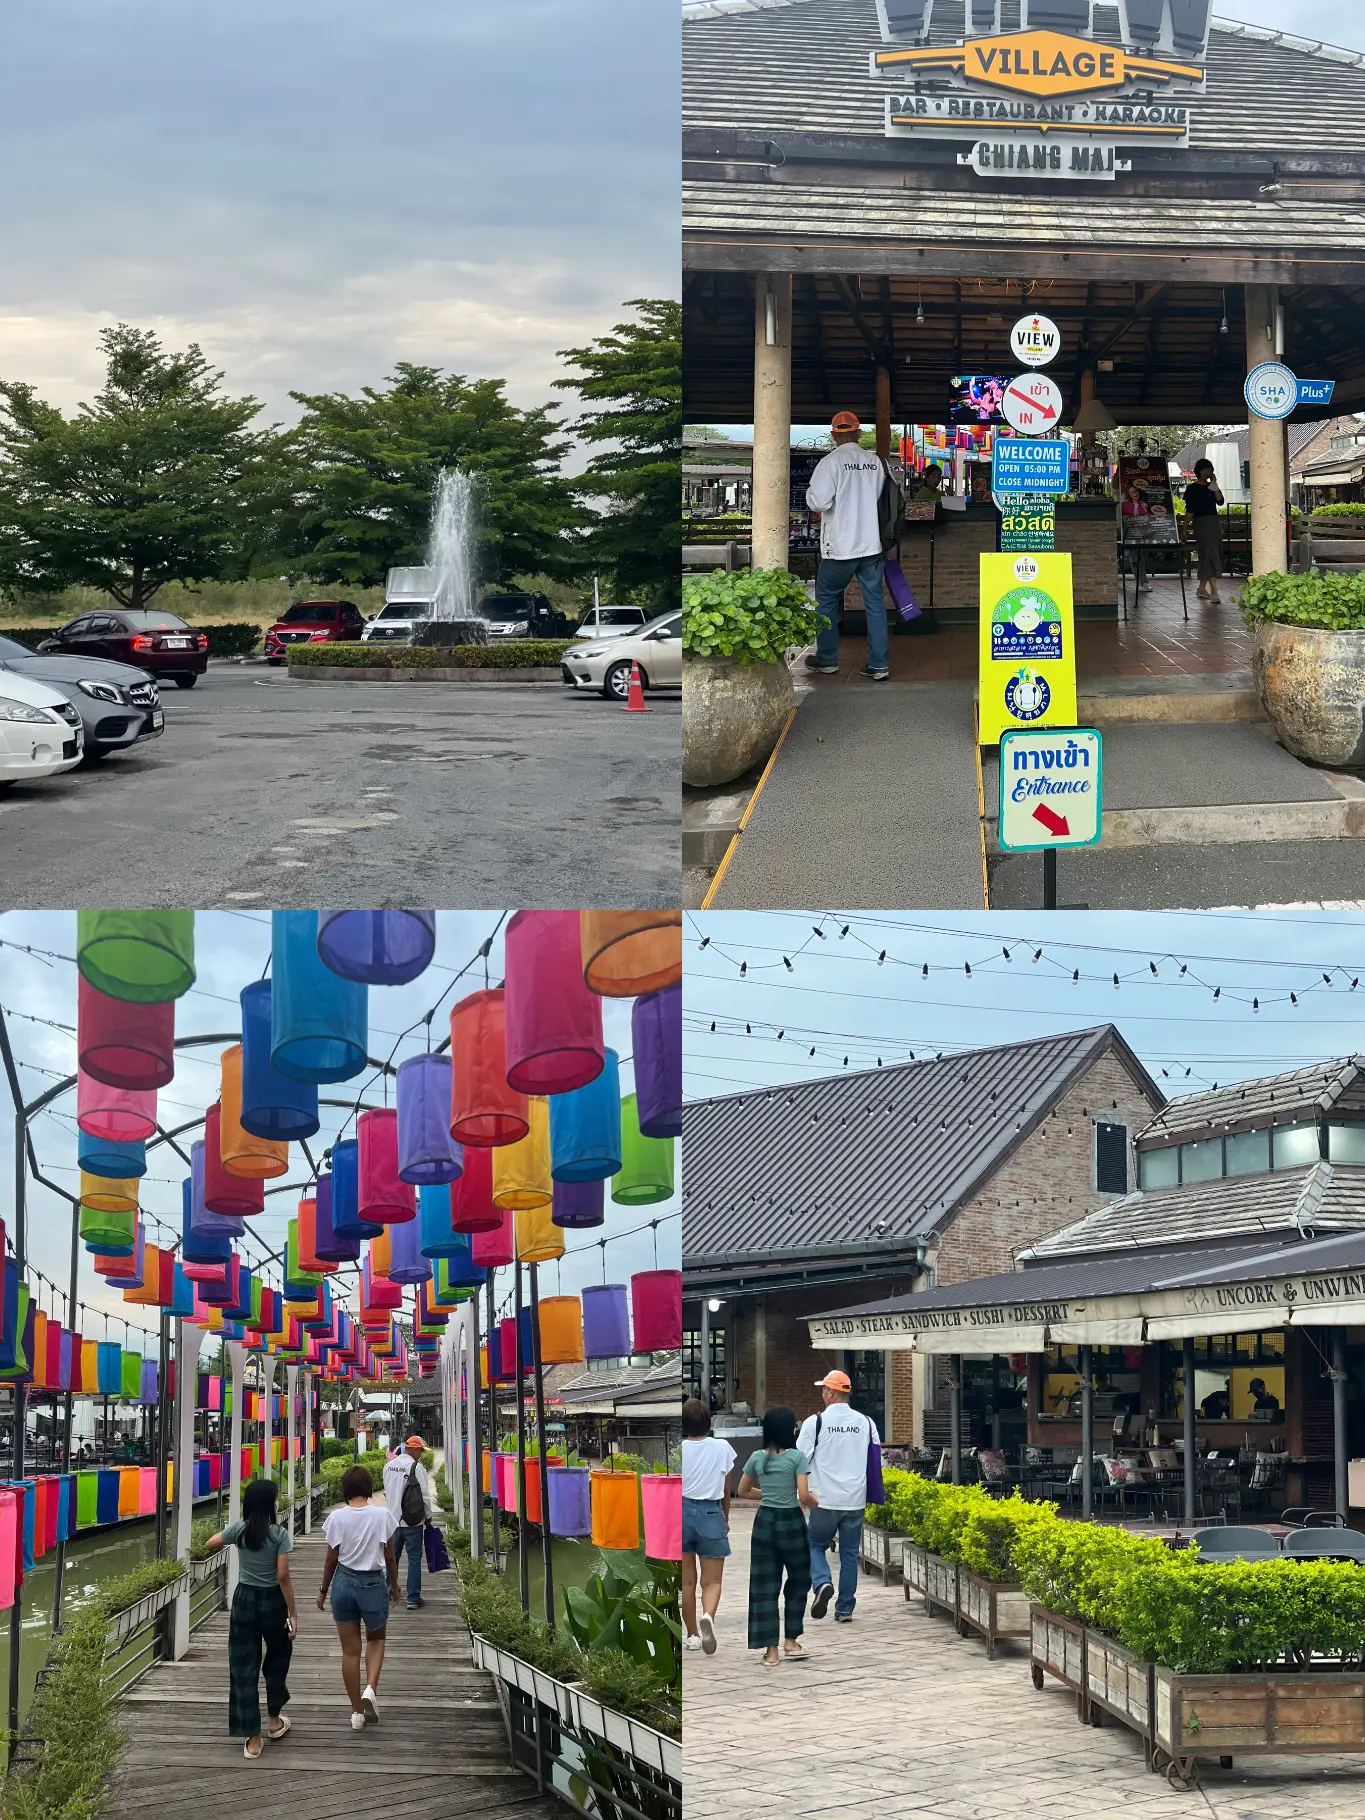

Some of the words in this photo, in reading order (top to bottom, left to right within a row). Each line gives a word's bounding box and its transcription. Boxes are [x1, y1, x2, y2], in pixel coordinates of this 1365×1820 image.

[975, 47, 1115, 79] VILLAGE
[889, 96, 928, 114] BAR
[948, 99, 1075, 122] RESTAURANT
[1094, 105, 1187, 124] KARAOKE
[978, 142, 1061, 169] CHIANG
[1071, 147, 1114, 172] MAI
[1017, 331, 1054, 347] VIEW
[1030, 382, 1050, 396] เข้า
[1260, 386, 1286, 396] SHA
[1019, 413, 1033, 424] IN
[999, 445, 1062, 461] WELCOME
[844, 463, 878, 471] THAILAND
[999, 464, 1020, 473] OPEN
[1024, 465, 1047, 474] 05:00
[1048, 465, 1061, 474] PM
[999, 478, 1022, 486] CLOSE
[1024, 478, 1065, 487] MIDNIGHT
[1002, 496, 1029, 506] Hello
[1002, 506, 1021, 516] 你好
[1001, 511, 1055, 531] สวัสดี
[1016, 564, 1036, 573] VIEW
[993, 600, 1007, 621] Clean
[1006, 588, 1025, 600] Food
[1028, 587, 1048, 601] Good
[1047, 600, 1060, 620] Taste
[1013, 739, 1090, 771] ทางเข้า
[1011, 775, 1092, 803] Entrance
[1216, 1284, 1278, 1306] UNCORK
[1282, 1282, 1298, 1302] &
[823, 1320, 855, 1335] SALAD
[861, 1317, 894, 1333] STEAK
[902, 1311, 963, 1330] SANDWICH
[970, 1308, 1006, 1326] SUSHI
[1014, 1303, 1070, 1322] DESSERT
[828, 1426, 860, 1434] THAILAND
